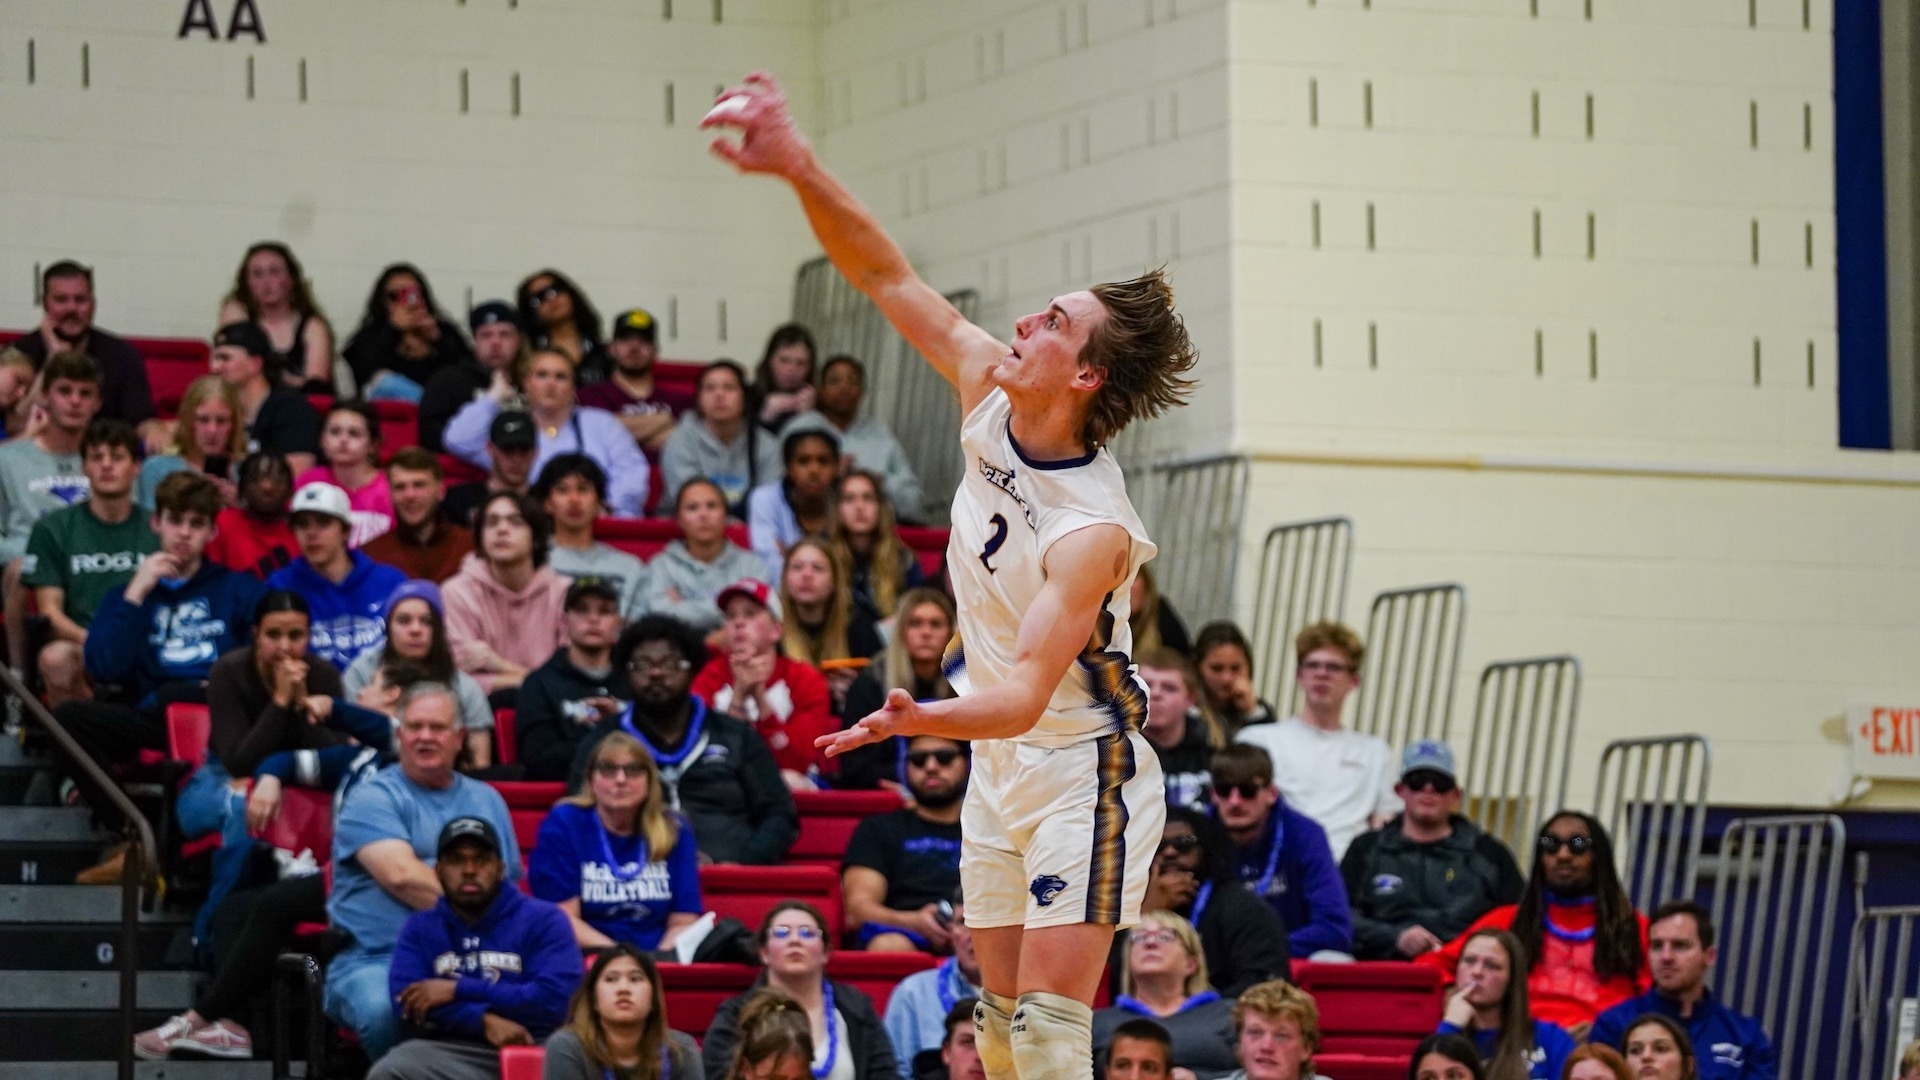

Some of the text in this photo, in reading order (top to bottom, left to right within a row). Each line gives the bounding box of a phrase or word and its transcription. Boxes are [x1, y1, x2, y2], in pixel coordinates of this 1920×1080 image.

[177, 0, 267, 43] AA
[978, 512, 1008, 576] 2
[582, 877, 672, 902] VOLLEYBALL
[96, 942, 114, 964] G
